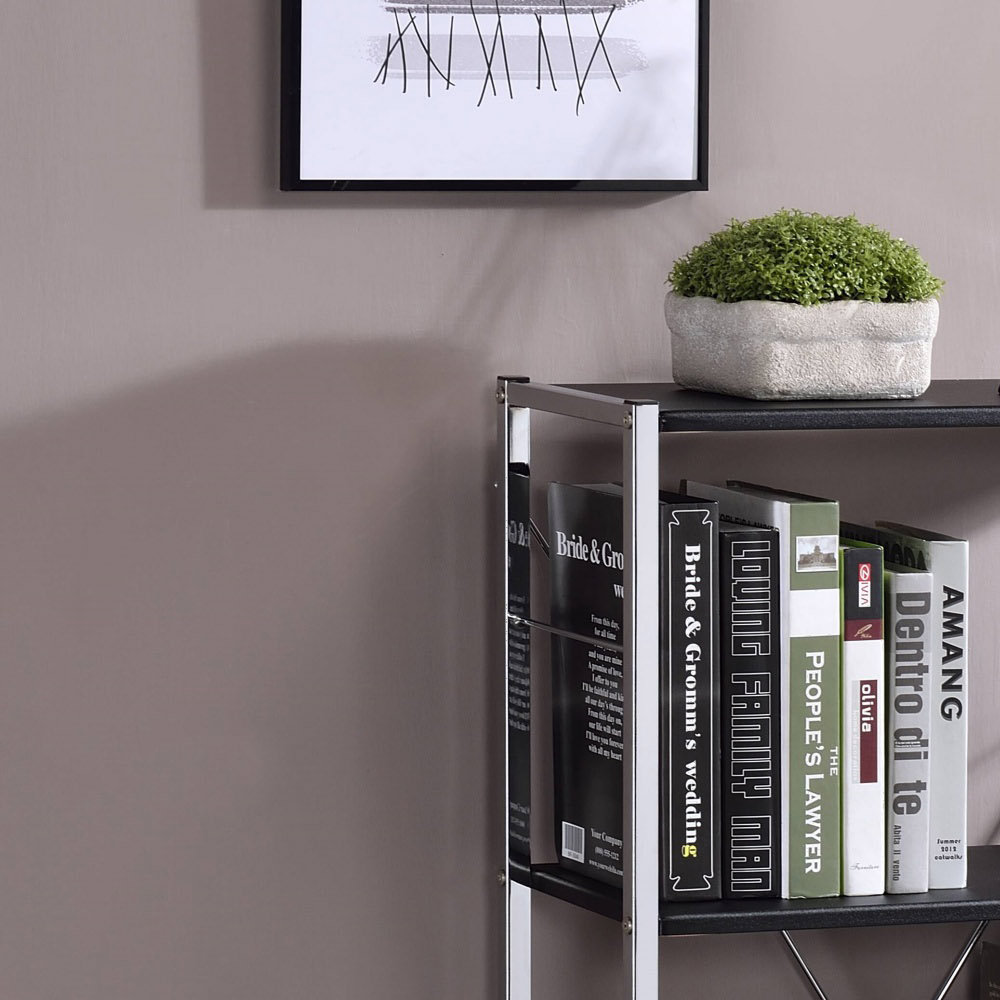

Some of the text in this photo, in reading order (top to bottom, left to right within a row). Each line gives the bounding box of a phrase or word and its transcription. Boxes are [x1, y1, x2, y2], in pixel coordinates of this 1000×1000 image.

[556, 531, 588, 562] Bride
[590, 538, 601, 565] &
[893, 592, 931, 714] Dentro
[940, 584, 964, 722] AMANG
[681, 543, 702, 858] Bride & Gromm's wedding
[861, 684, 876, 733] olivia
[731, 672, 772, 799] FAMILY
[893, 727, 929, 761] di
[803, 651, 825, 874] PEOPLE'S LAWYER
[829, 746, 838, 776] THE
[892, 780, 927, 815] te
[893, 824, 902, 845] Abita
[892, 859, 901, 882] vento
